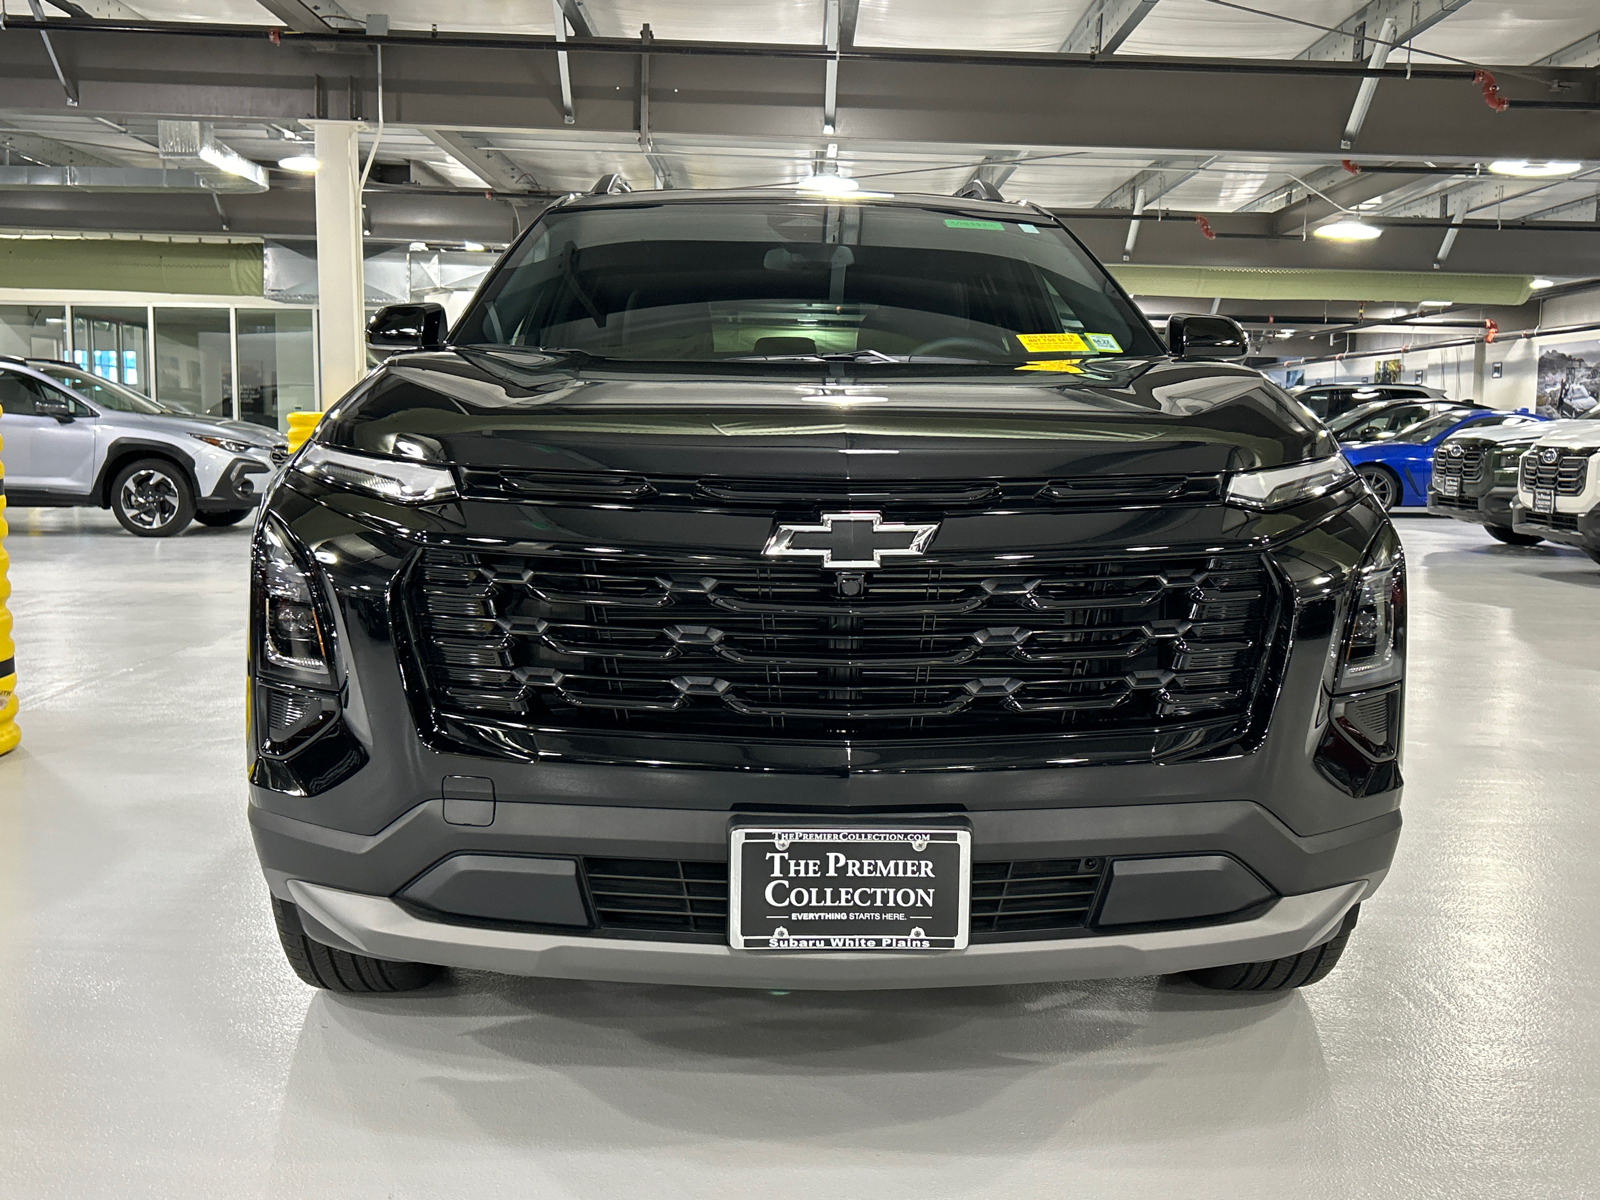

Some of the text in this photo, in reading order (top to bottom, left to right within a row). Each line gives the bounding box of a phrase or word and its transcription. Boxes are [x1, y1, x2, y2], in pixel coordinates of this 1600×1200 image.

[765, 852, 936, 878] THE PREMIER
[764, 879, 936, 908] COLLECTION
[790, 912, 908, 921] EVERYTHING STARTS HERE.
[768, 937, 931, 948] Subaru White Plains
